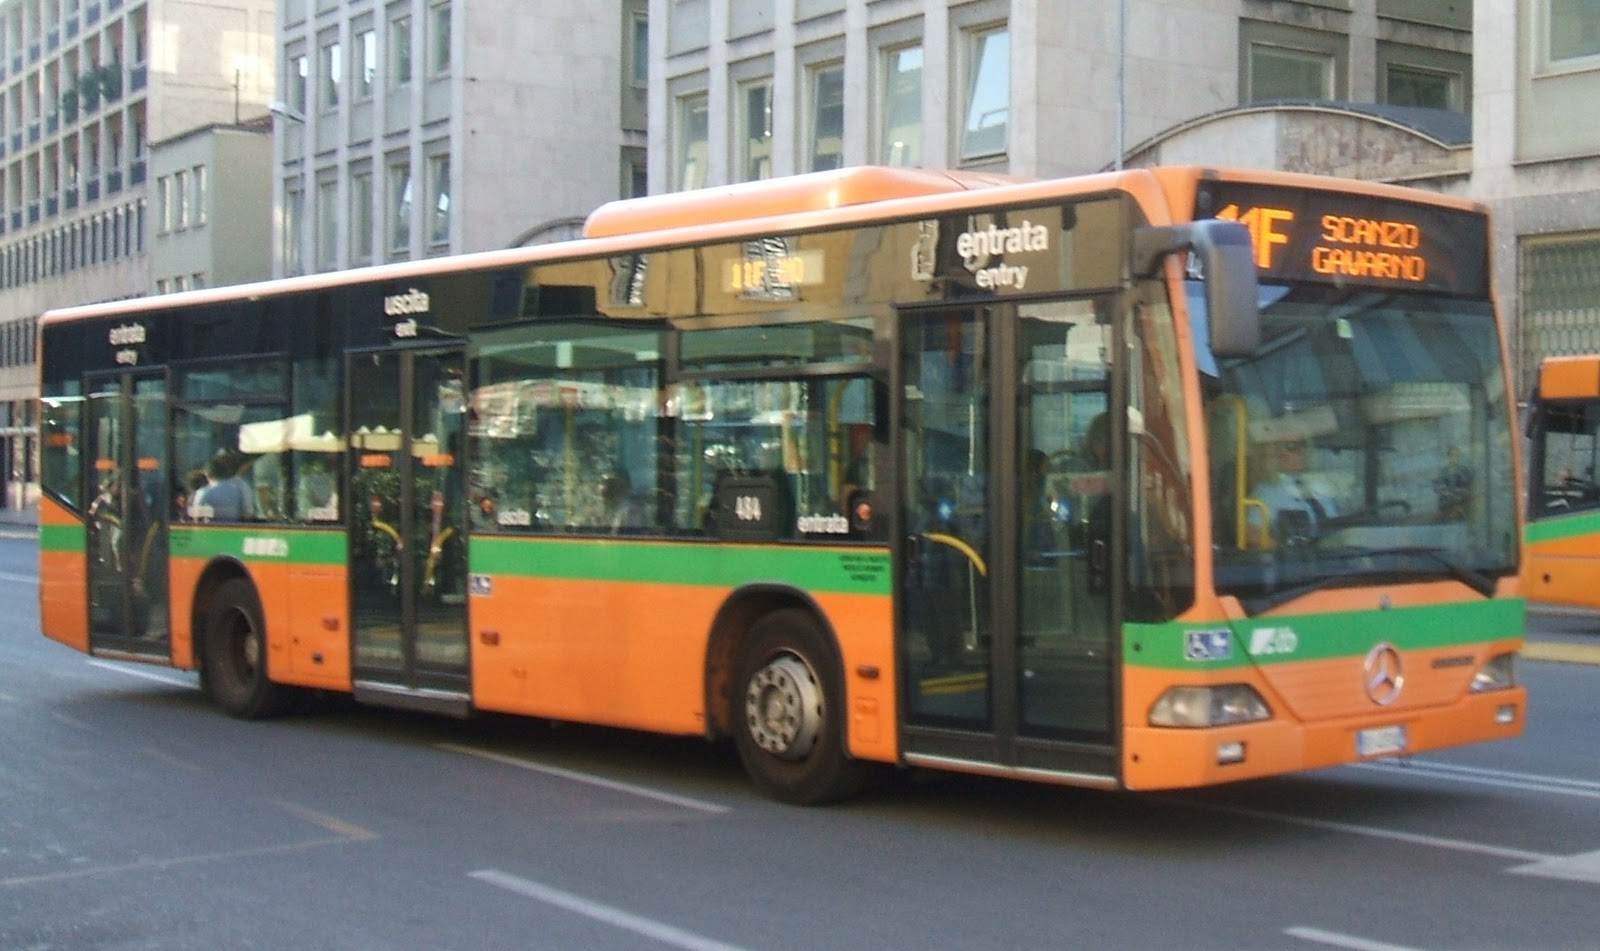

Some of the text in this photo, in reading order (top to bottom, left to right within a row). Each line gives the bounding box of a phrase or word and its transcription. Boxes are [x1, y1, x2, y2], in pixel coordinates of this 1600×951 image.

[957, 220, 1049, 258] entrata
[1215, 204, 1294, 268] 1F
[1321, 214, 1420, 249] SCANZO
[975, 262, 1029, 290] entry
[1312, 246, 1426, 281] GAVARNO
[384, 288, 430, 316] uscita
[797, 513, 849, 534] entrata
